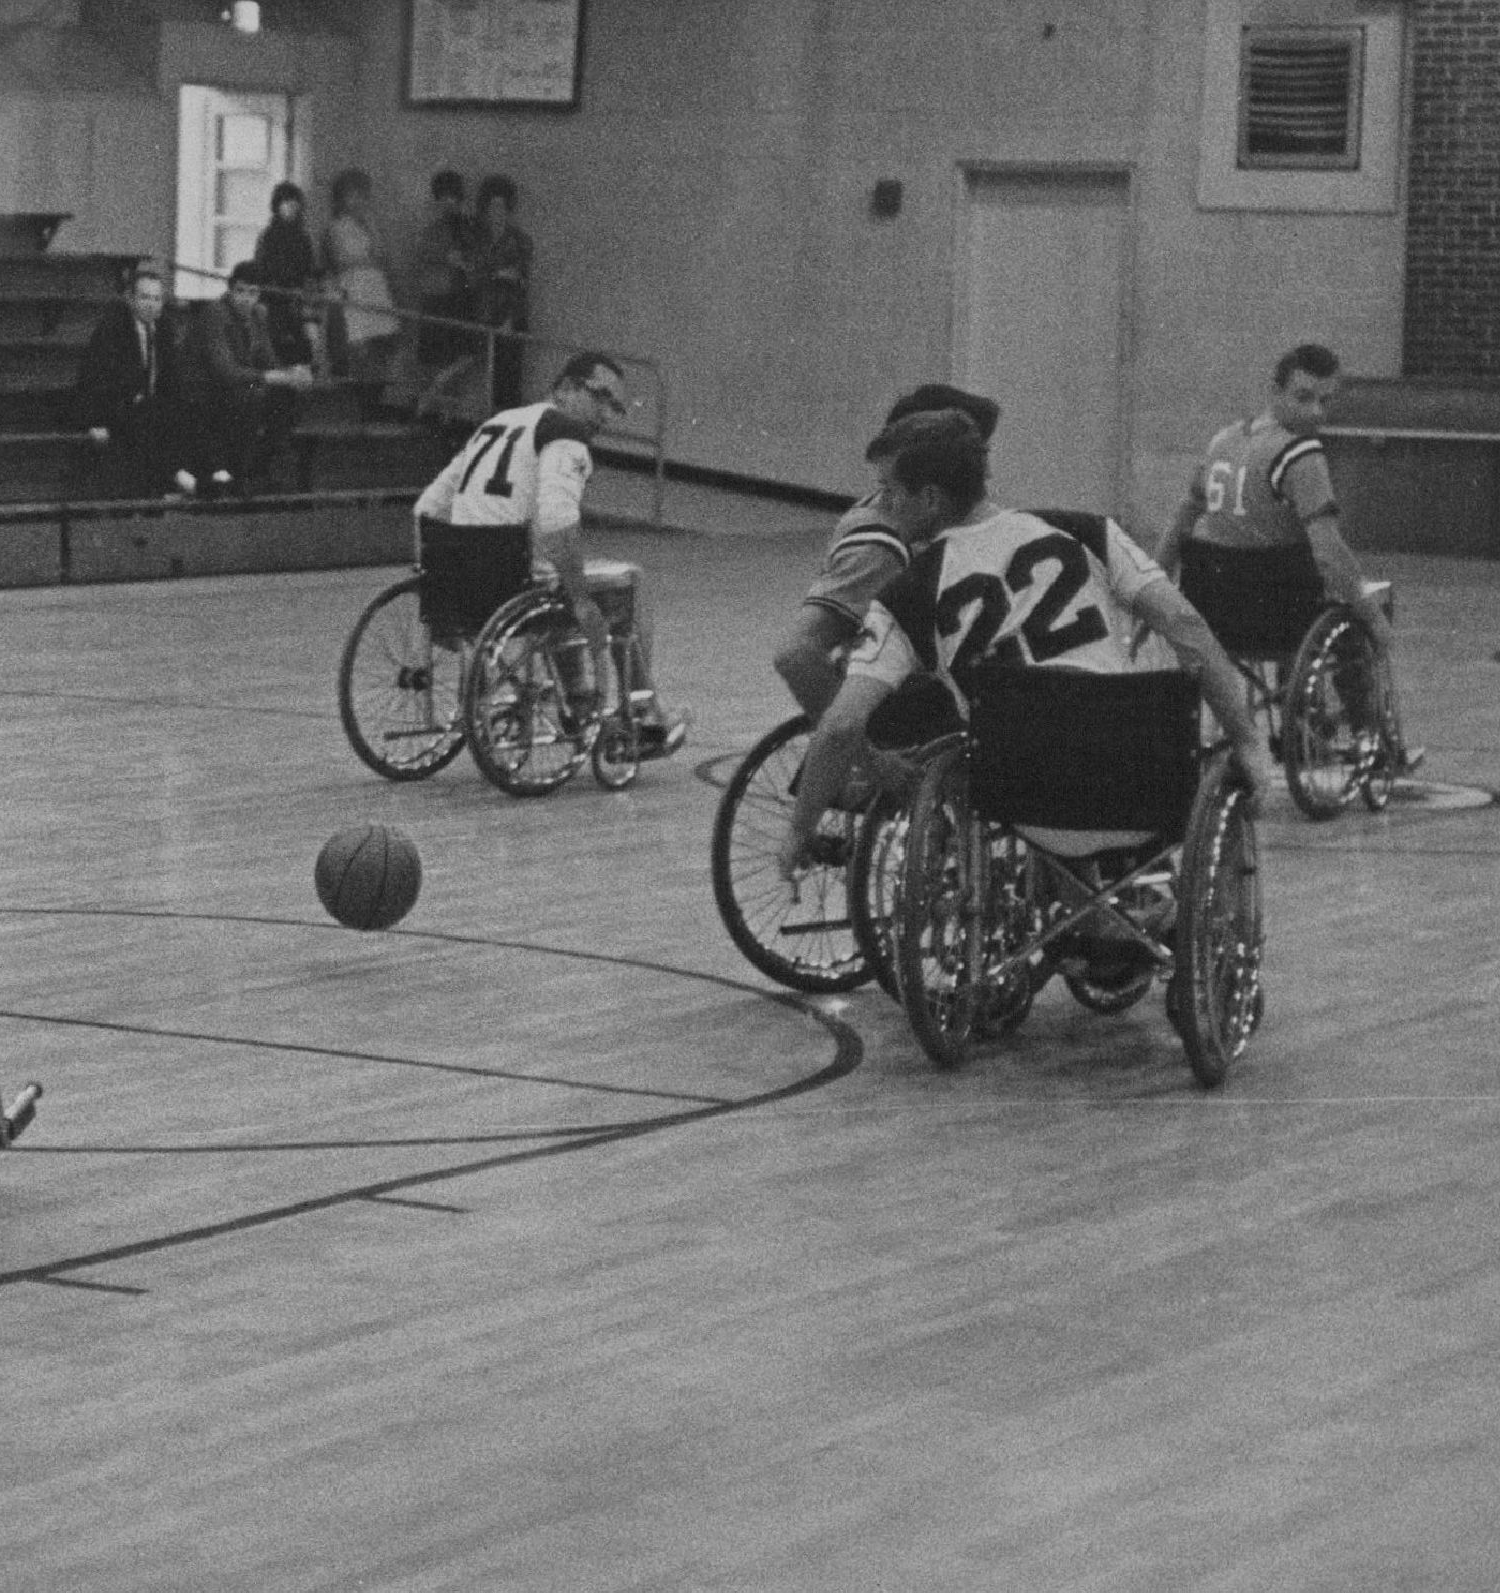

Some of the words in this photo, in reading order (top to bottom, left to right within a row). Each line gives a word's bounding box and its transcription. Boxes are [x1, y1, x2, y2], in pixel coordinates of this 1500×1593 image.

[458, 424, 527, 499] 71
[1205, 461, 1247, 517] 61
[937, 533, 1109, 690] 22
